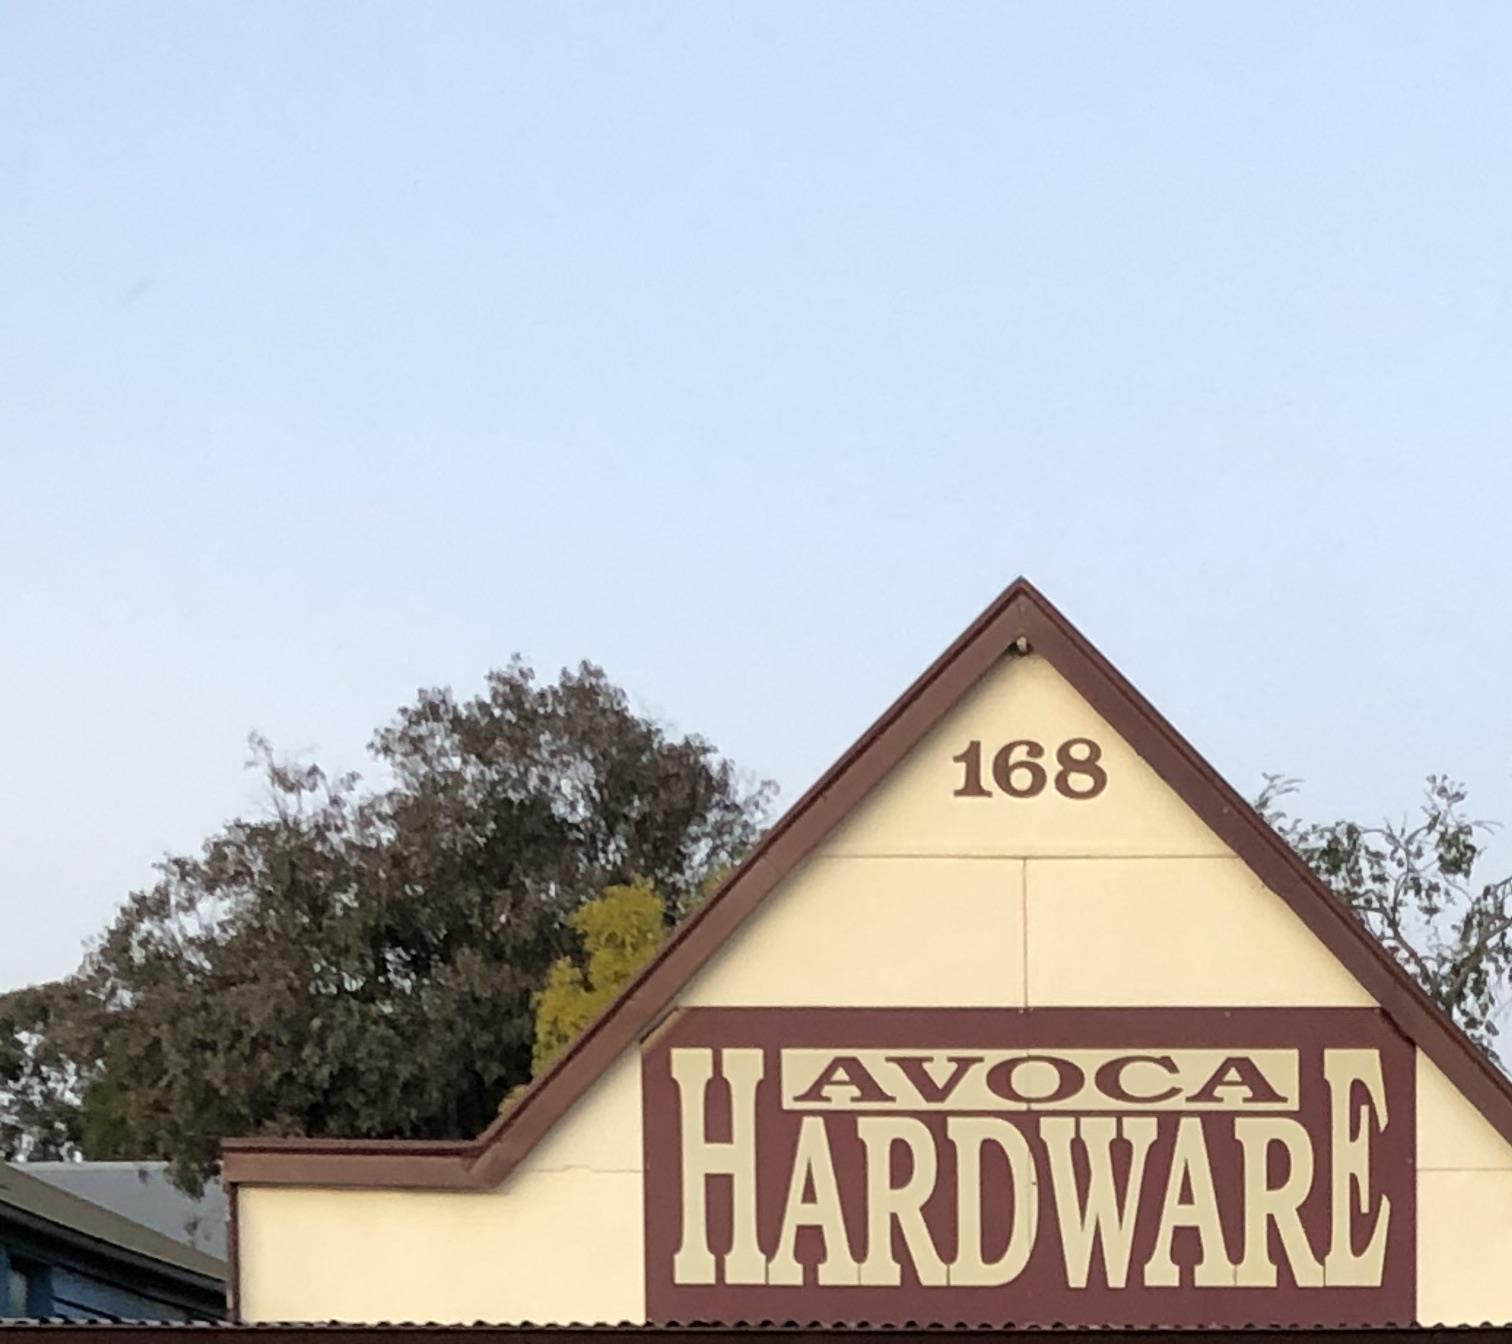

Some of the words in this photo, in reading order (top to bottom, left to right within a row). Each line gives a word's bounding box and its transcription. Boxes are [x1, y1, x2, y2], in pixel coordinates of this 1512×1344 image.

[952, 738, 1108, 799] 168
[792, 1055, 1289, 1104] AVOCA
[670, 1047, 1390, 1289] HARDWARE
